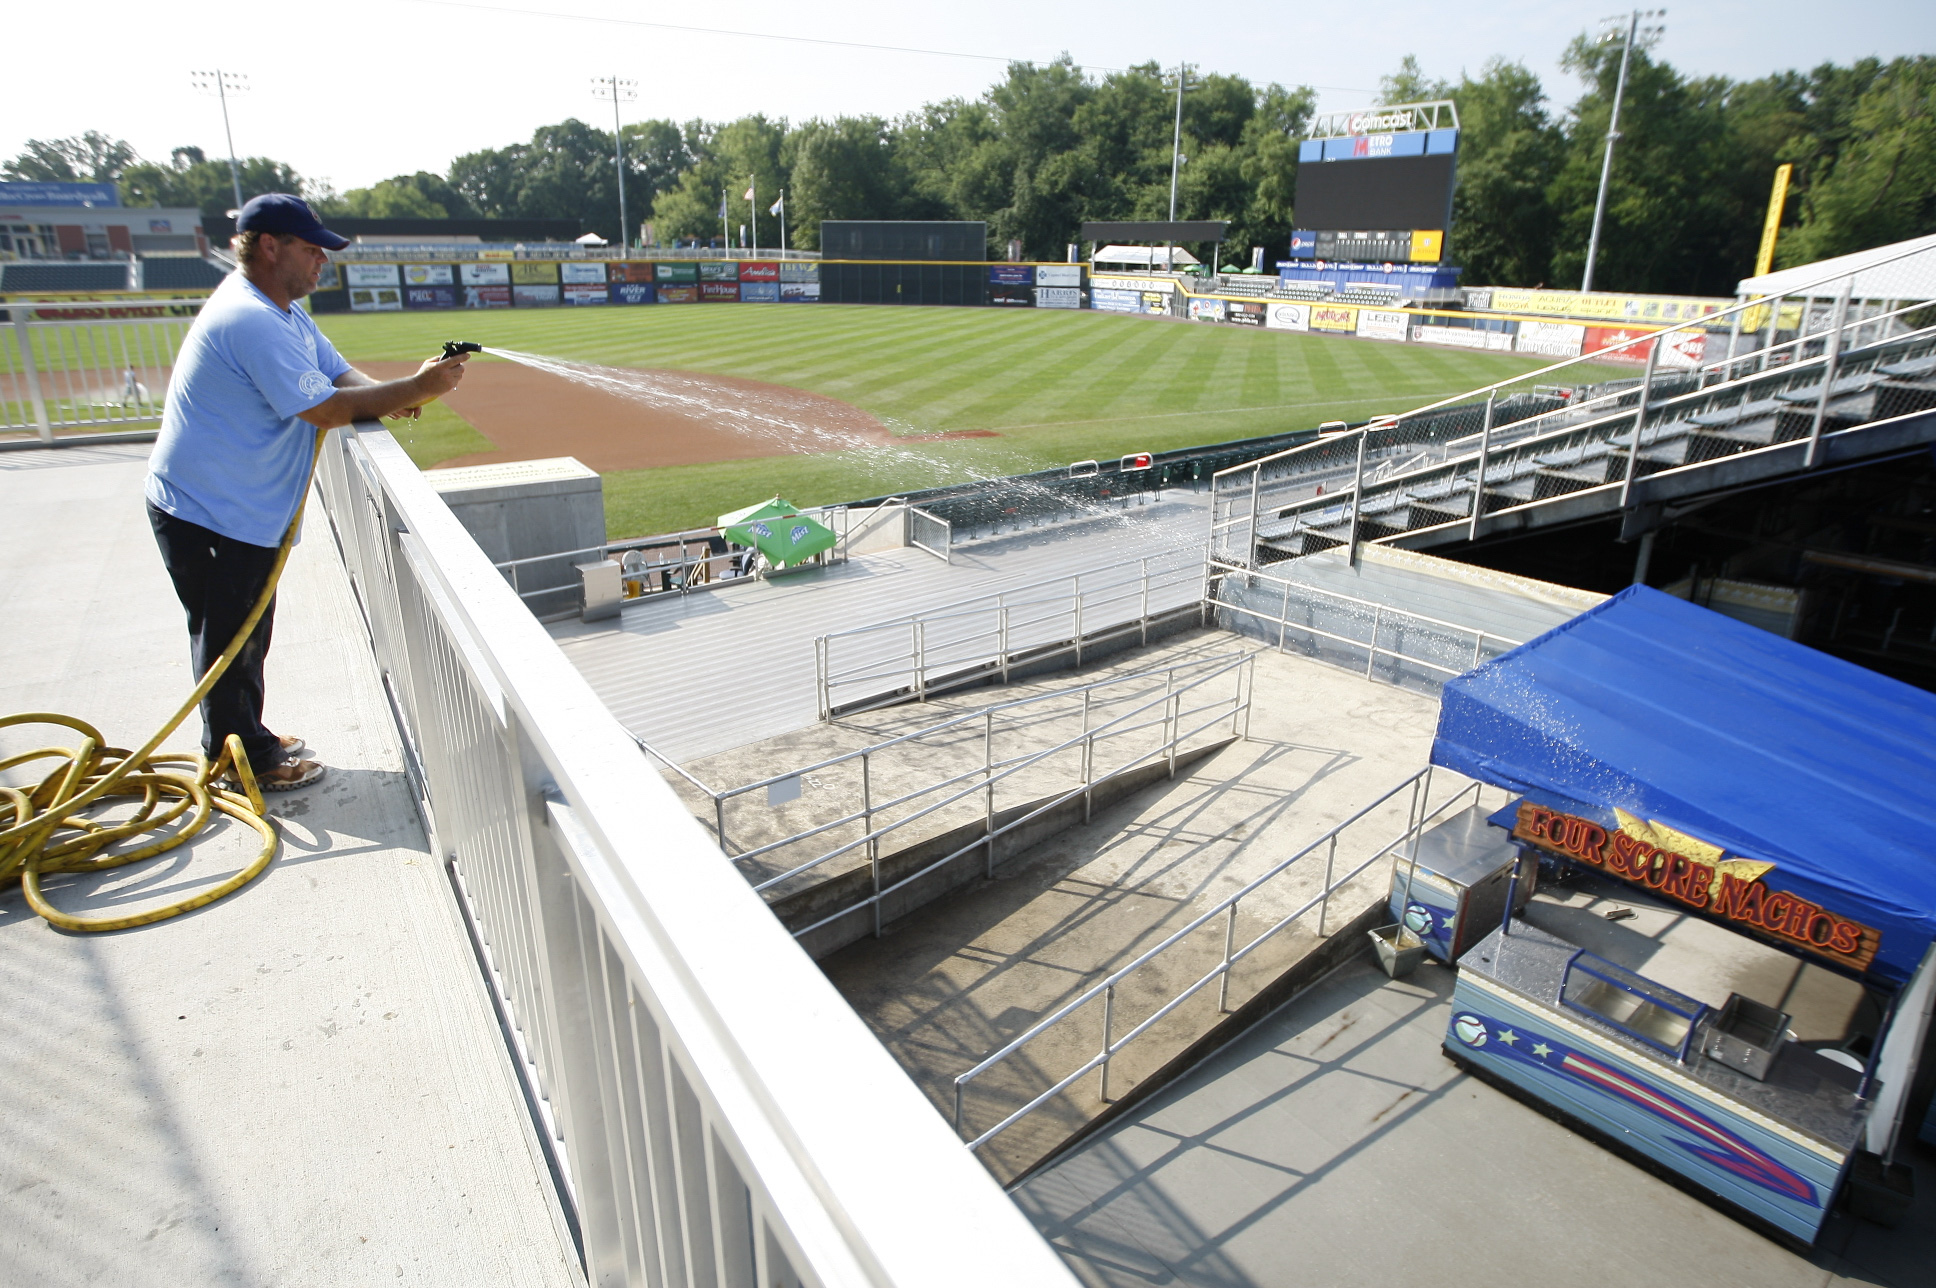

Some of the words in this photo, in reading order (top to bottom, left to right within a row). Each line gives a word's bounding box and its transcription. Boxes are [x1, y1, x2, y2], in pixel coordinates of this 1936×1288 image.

[1353, 135, 1393, 157] METRO
[1369, 148, 1392, 156] BANK
[1041, 289, 1078, 299] HARRIS
[1539, 295, 1573, 304] ACURA
[1498, 301, 1530, 309] TOYOTA
[791, 526, 809, 545] Mist
[1530, 809, 1606, 864] FOUR
[1608, 834, 1712, 906] SCORE
[1714, 873, 1862, 954] NACHOS
